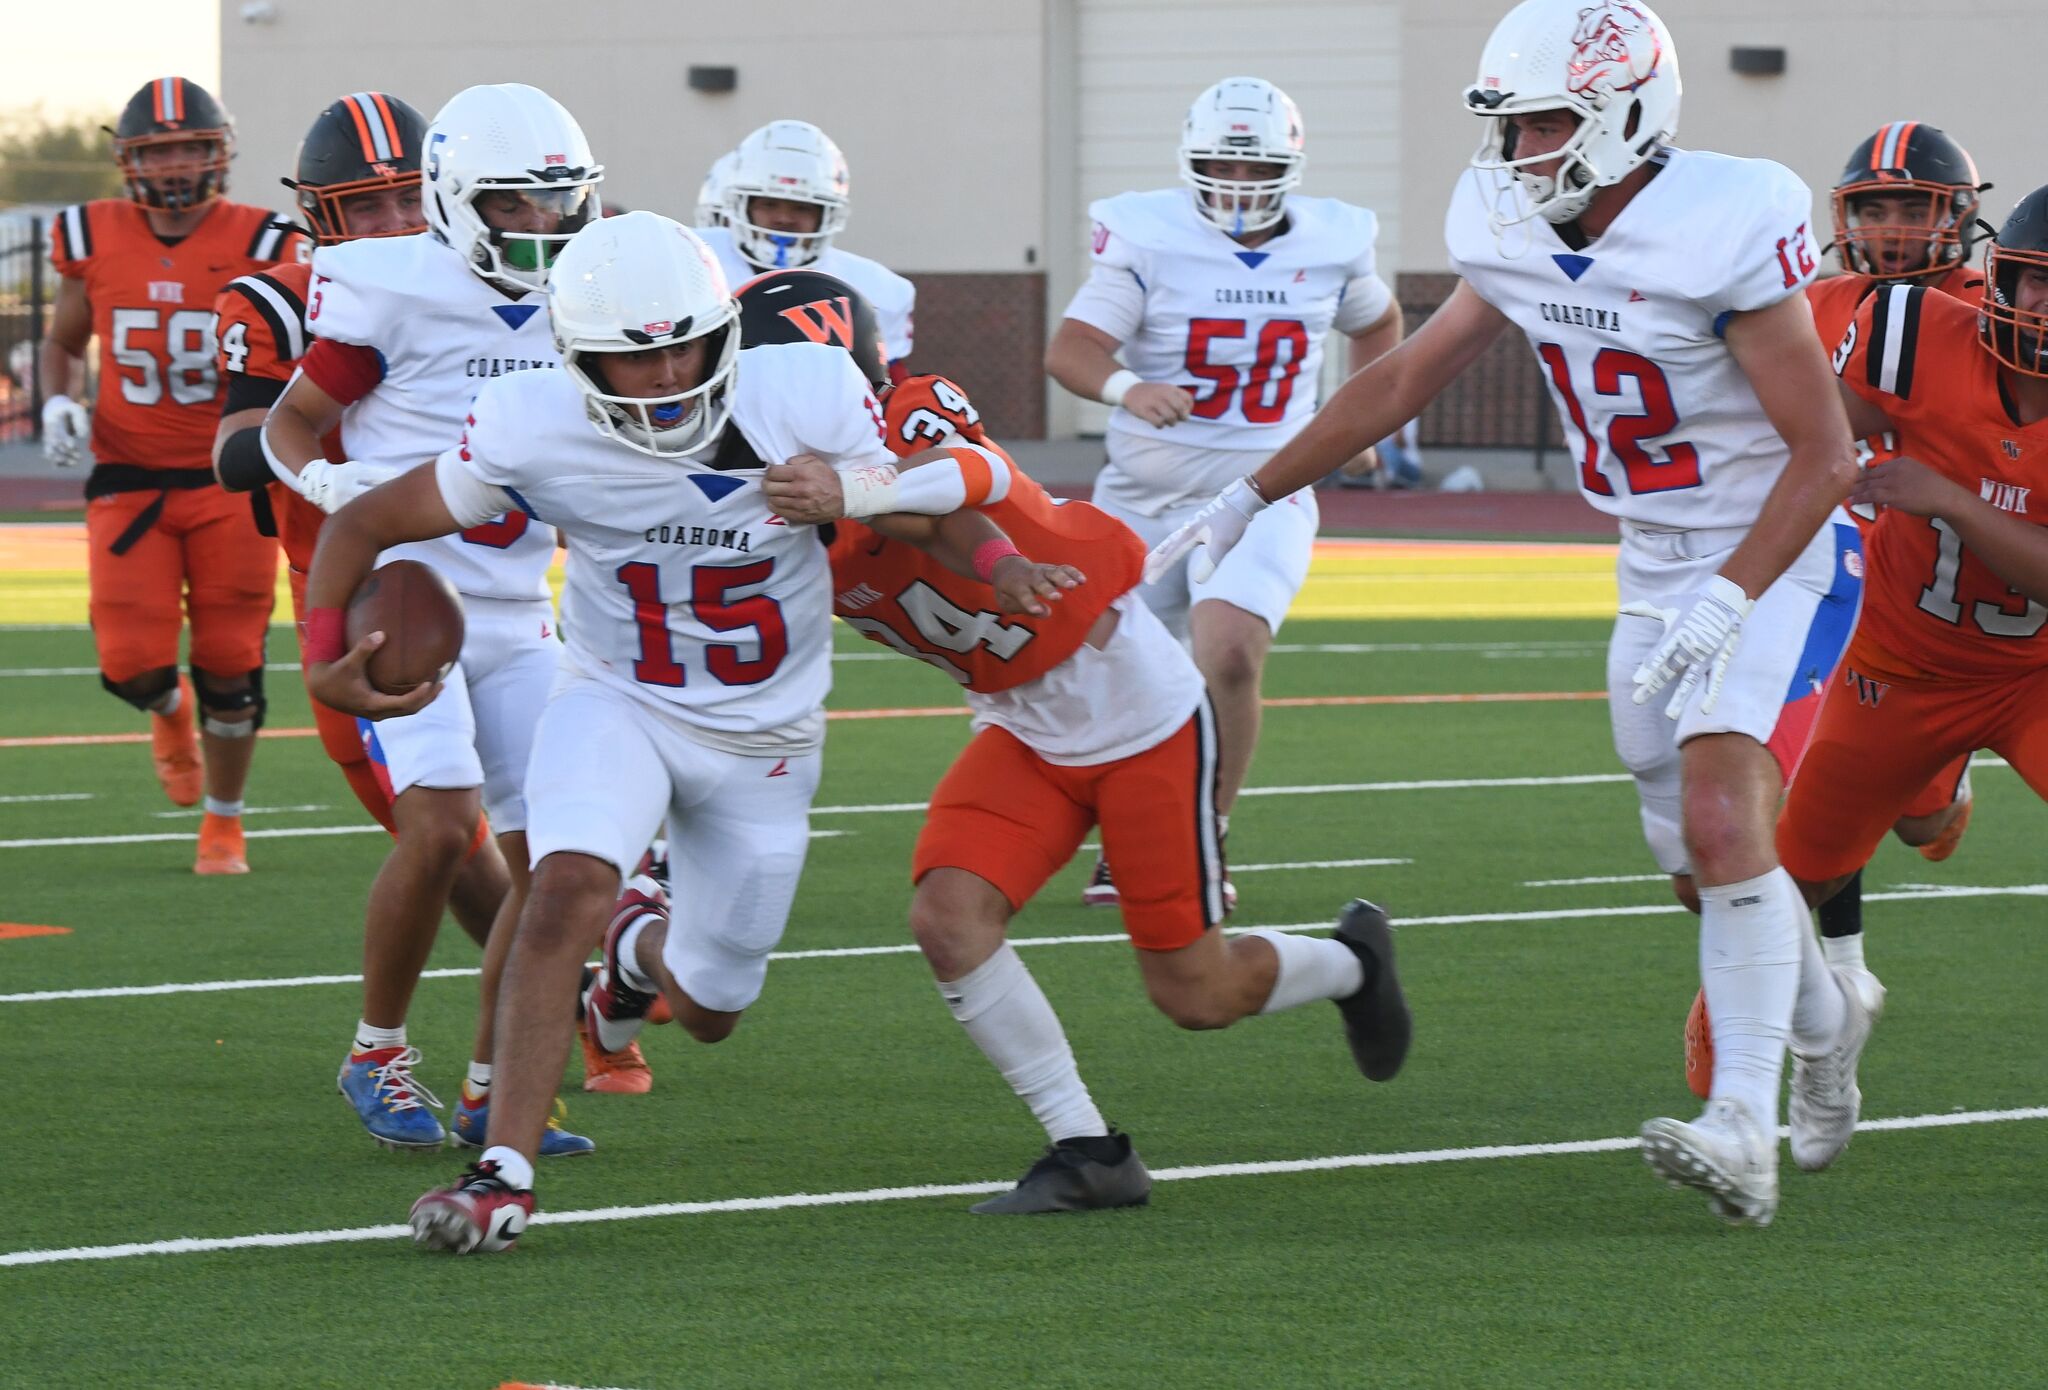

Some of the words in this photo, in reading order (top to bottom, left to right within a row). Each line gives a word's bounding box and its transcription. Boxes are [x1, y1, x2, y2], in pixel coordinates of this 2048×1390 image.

[1776, 222, 1815, 289] 12
[777, 296, 854, 352] W
[1215, 289, 1288, 305] COAHOMA
[1540, 302, 1621, 332] COAHOMA
[112, 307, 219, 406] 58
[1177, 317, 1309, 423] 50
[900, 379, 981, 446] 34
[1538, 341, 1703, 497] 12
[1980, 477, 2031, 514] WINK
[645, 525, 751, 552] COAHOMA
[616, 556, 789, 688] 15
